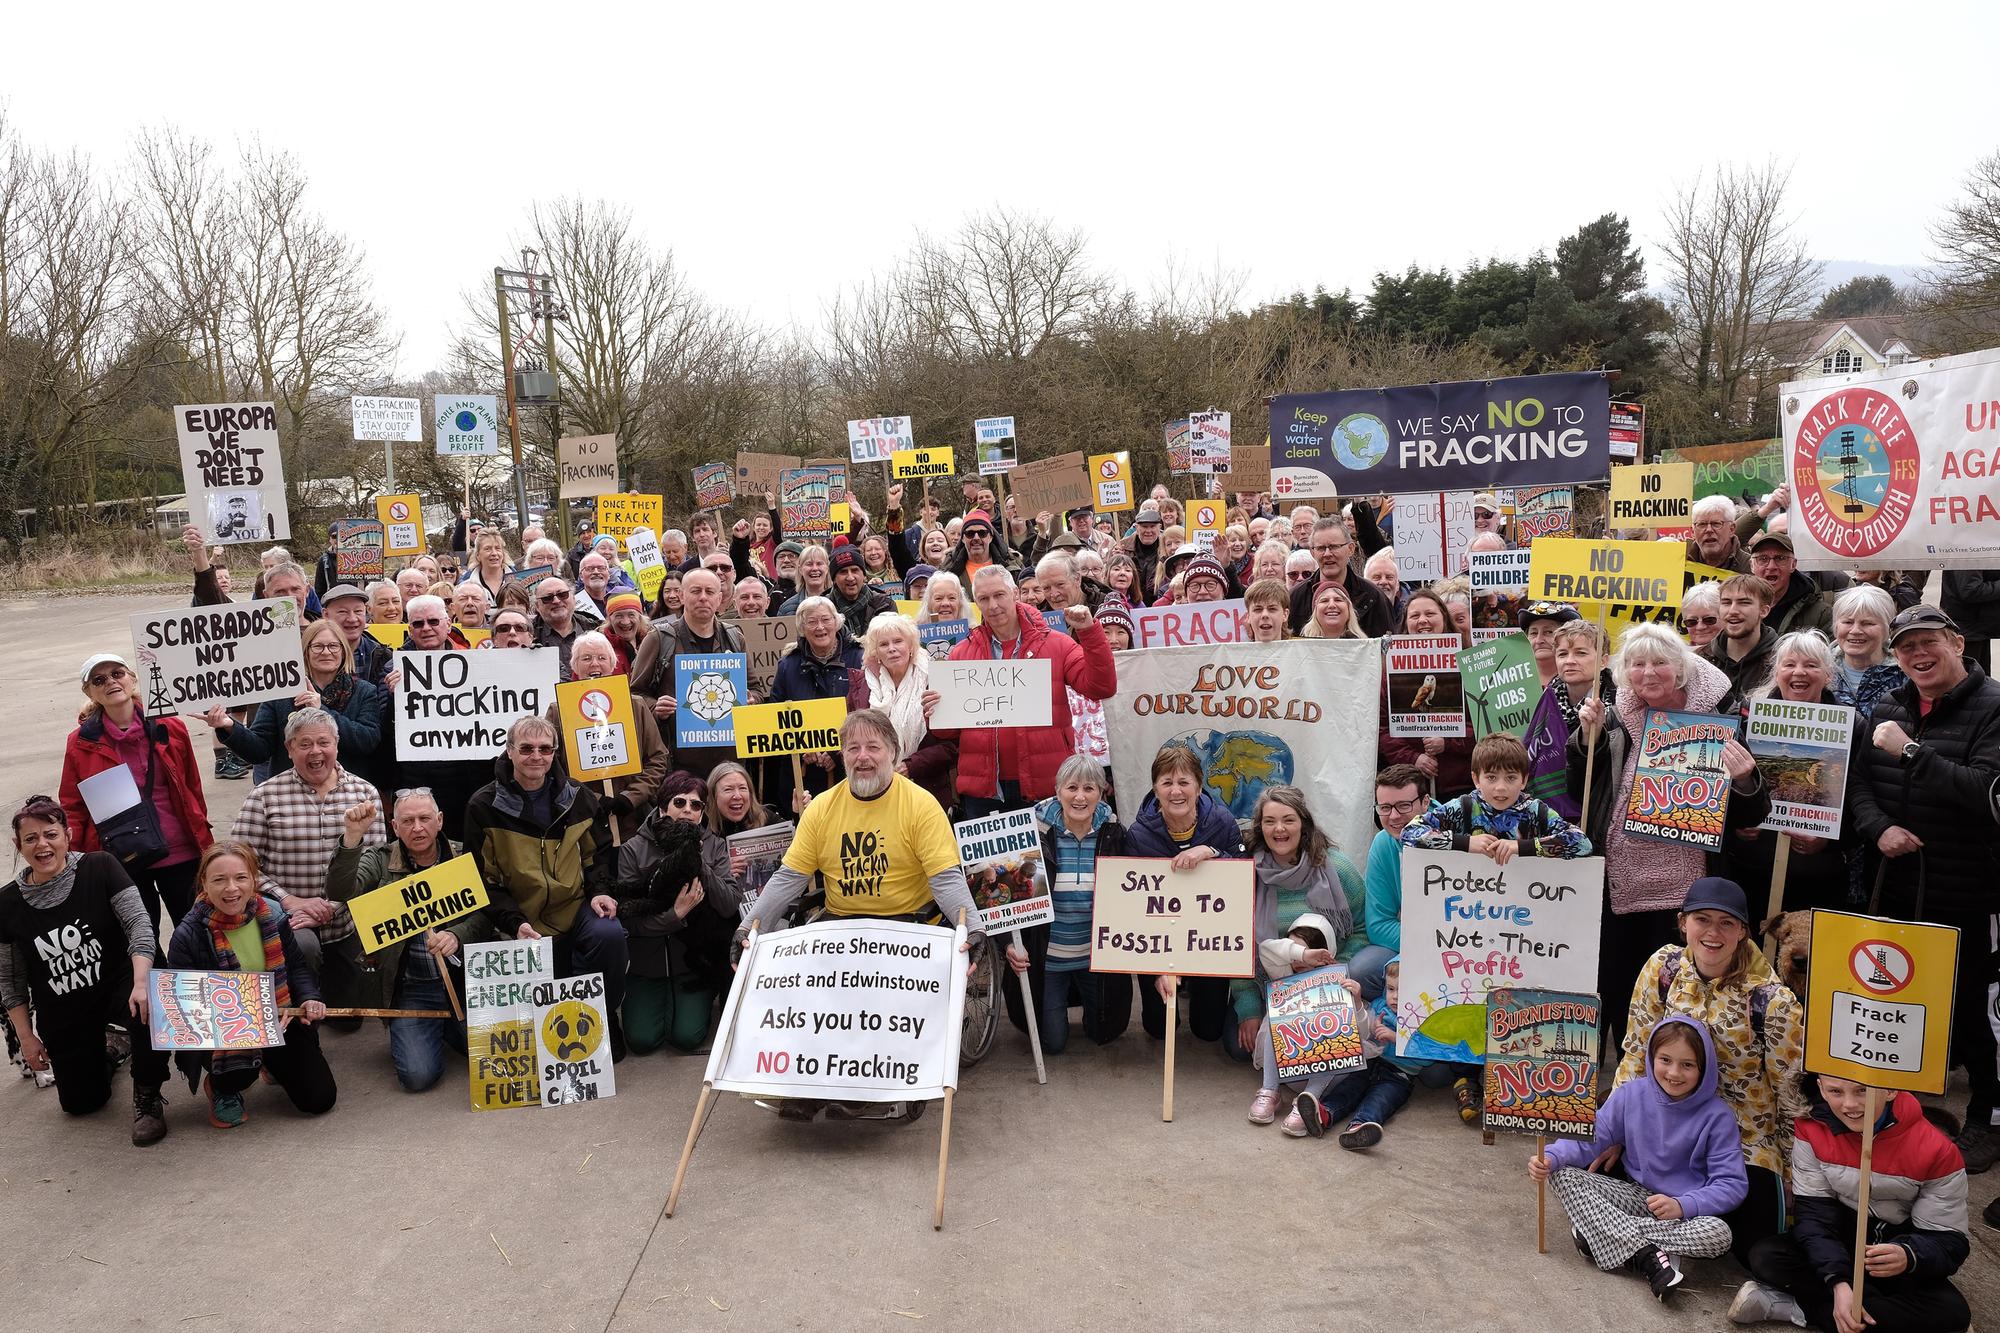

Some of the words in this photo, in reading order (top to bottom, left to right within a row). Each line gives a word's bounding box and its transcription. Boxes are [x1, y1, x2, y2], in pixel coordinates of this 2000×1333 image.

[354, 399, 375, 409] GAS
[378, 400, 419, 410] FRACKING
[185, 407, 277, 433] EUROPA
[360, 421, 384, 431] STAY
[386, 422, 400, 431] OUT
[401, 422, 411, 431] OF
[391, 411, 414, 421] FINITE
[436, 406, 455, 430] PEOPLE
[455, 401, 475, 409] AND
[475, 405, 497, 431] PLANET
[1191, 413, 1223, 424] DON'T
[1294, 407, 1328, 427] Keep
[1397, 418, 1433, 437] WE
[1441, 414, 1480, 433] SAY
[1488, 398, 1544, 429] NO
[1553, 405, 1584, 424] TO
[361, 431, 406, 440] YORKSHIRE
[857, 418, 904, 436] STOP
[981, 428, 1008, 438] WATER
[1192, 432, 1204, 440] US
[1199, 423, 1231, 440] POISON
[1290, 422, 1308, 433] air
[1798, 396, 1849, 459] FRACK
[1861, 397, 1906, 448] FREE
[207, 431, 239, 450] WE
[448, 434, 484, 443] BEFORE
[450, 443, 484, 451] PROFIT
[578, 442, 598, 455] NO
[852, 436, 914, 459] EUROPA
[1286, 434, 1323, 446] water
[1400, 429, 1588, 469] FRACKING
[196, 448, 264, 469] DON'T
[915, 453, 930, 464] NO
[1192, 456, 1230, 466] FRACKING
[1285, 447, 1320, 459] clean
[203, 466, 264, 487] NEED
[561, 461, 615, 484] FRACKING
[899, 462, 950, 477] FRACKING
[1213, 464, 1228, 473] NO
[1797, 467, 1815, 487] FFS
[1894, 458, 1917, 481] FFS
[1103, 482, 1121, 490] Frack
[1641, 474, 1661, 493] NO
[603, 500, 626, 509] ONCE
[631, 501, 657, 510] THEY
[1613, 498, 1688, 518] FRACKING
[605, 512, 650, 523] FRACK
[233, 528, 260, 540] YOU
[1398, 529, 1424, 545] SAY
[1433, 527, 1468, 548] YES
[631, 541, 657, 556] FRACK
[639, 553, 655, 564] OFF!
[1472, 554, 1514, 566] PROTECT
[1590, 548, 1624, 573] NO
[1543, 574, 1668, 602] FRACKING
[146, 606, 275, 649] SCARBADOS
[195, 642, 238, 666] NOT
[680, 659, 709, 671] DON'T
[710, 658, 741, 670] FRACK
[1391, 653, 1457, 670] WILDLIFE
[1461, 655, 1472, 665] WE
[1472, 646, 1497, 661] DEMAND
[172, 660, 301, 703] SCARGASEOUS
[402, 653, 469, 692] NO
[952, 666, 1027, 689] FRACK
[1479, 661, 1533, 692] CLIMATE
[963, 696, 1014, 713] OFF!
[1133, 693, 1199, 717] OUR
[1199, 695, 1322, 723] WORLD
[1494, 687, 1527, 710] JOBS
[778, 709, 803, 730] NO
[1391, 715, 1405, 723] SAY
[1406, 715, 1416, 723] NO
[1417, 714, 1427, 723] TO
[1427, 714, 1463, 723] FRACKING
[1498, 708, 1530, 731] NOW
[1755, 703, 1815, 720] PROTECT
[1818, 708, 1847, 724] OUR
[746, 727, 840, 754] FRACKING
[1645, 721, 1737, 755] BURNISTON
[1751, 721, 1847, 743] COUNTRYSIDE
[591, 755, 617, 764] Zone
[1649, 752, 1687, 768] SAYS
[1775, 804, 1787, 815] TO
[1788, 806, 1838, 822] FRACKING
[958, 817, 1006, 839] PROTECT
[1007, 812, 1032, 828] OUR
[1624, 820, 1660, 837] EUROPA
[1661, 828, 1680, 839] GO
[1681, 831, 1720, 847] HOME!
[736, 843, 767, 855] Socialist
[840, 832, 877, 858] NO
[961, 831, 1037, 862] CHILDREN
[837, 876, 884, 897] WAY!
[1121, 871, 1165, 892] SAY
[1423, 864, 1507, 896] Protect
[400, 880, 433, 908] NO
[1146, 895, 1182, 914] NO
[1196, 894, 1226, 914] TO
[372, 887, 477, 945] FRACKING
[1012, 900, 1050, 915] FRACKING
[1444, 896, 1533, 926] Future
[34, 924, 82, 961] NO
[773, 940, 808, 959] Frack
[812, 938, 845, 955] Free
[849, 937, 931, 959] Sherwood
[1098, 926, 1173, 954] FOSSIL
[1187, 929, 1244, 952] FUELS
[1436, 927, 1483, 949] Not
[1498, 932, 1570, 959] Their
[467, 946, 542, 979] GREEN
[1441, 951, 1524, 979] Profit
[532, 982, 559, 1007] OIL
[571, 976, 603, 1000] GAS
[756, 972, 801, 990] Forest
[806, 971, 836, 989] and
[840, 971, 940, 993] Edwinstowe
[759, 1007, 806, 1029] Asks
[813, 1012, 852, 1035] you
[859, 1008, 882, 1031] to
[888, 1014, 925, 1039] say
[1490, 1002, 1597, 1038] BURNISTON
[1850, 1001, 1907, 1024] Frack
[490, 1028, 532, 1055] NOT
[1500, 1033, 1543, 1054] SAYS
[1855, 1022, 1899, 1044] Free
[1850, 1042, 1900, 1064] Zone
[545, 1060, 601, 1081] SPOIL
[756, 1051, 790, 1075] NO
[796, 1053, 819, 1075] to
[826, 1054, 919, 1085] Fracking
[1485, 1113, 1525, 1129] EUROPA
[1526, 1117, 1547, 1131] GO
[1549, 1119, 1594, 1136] HOME!
